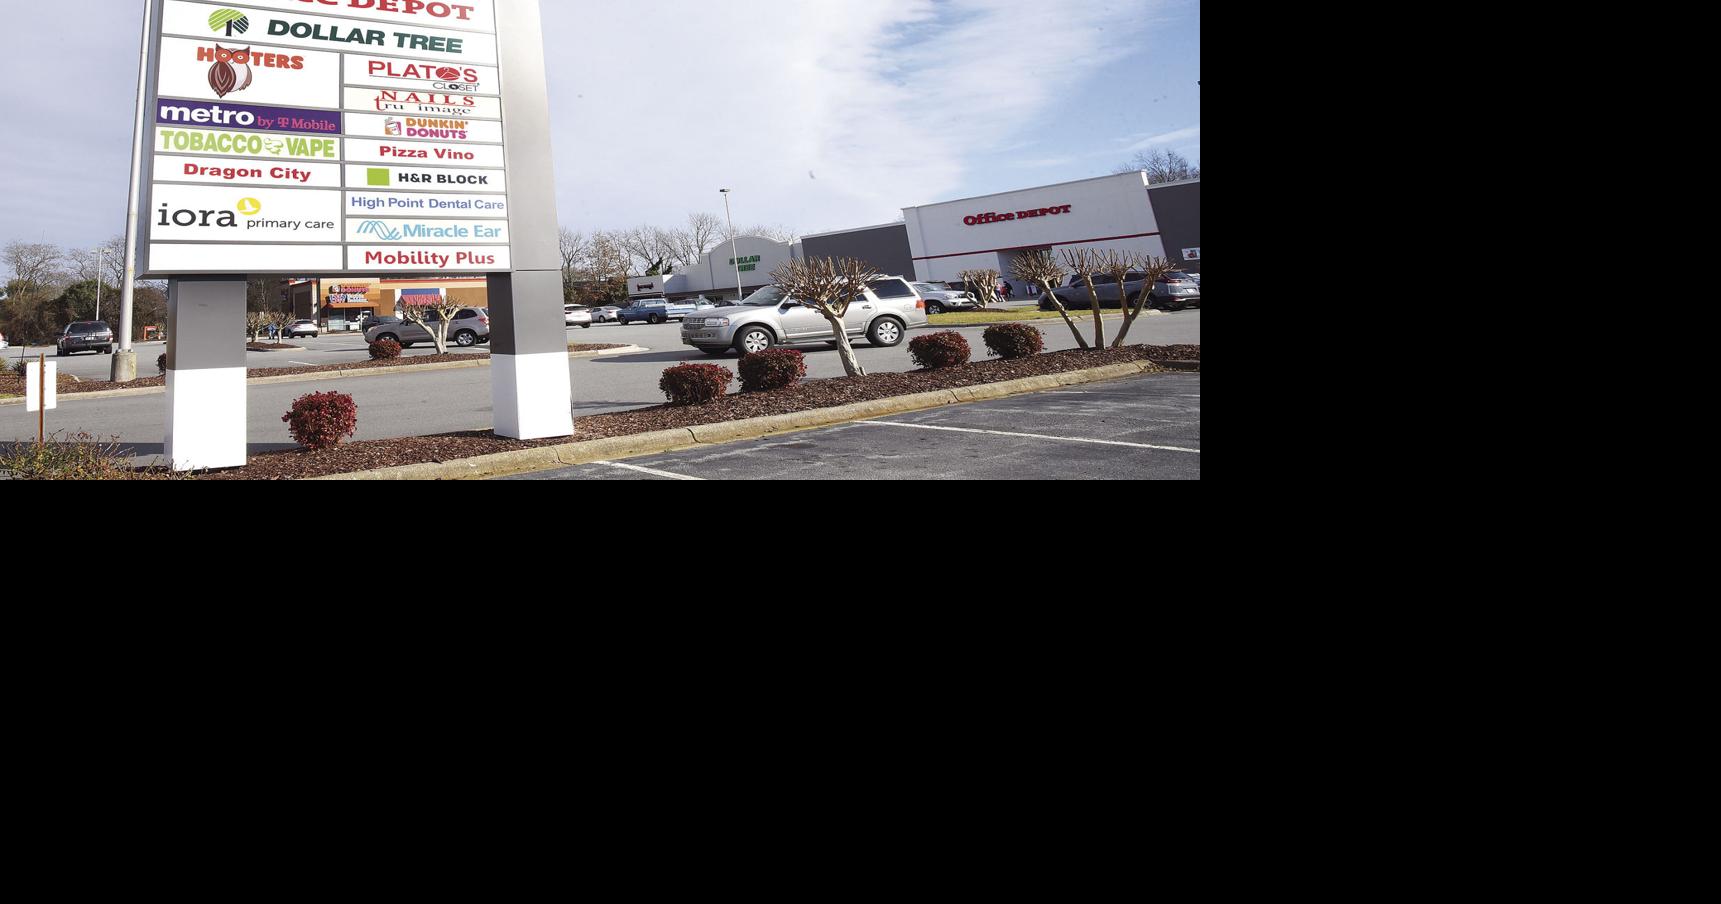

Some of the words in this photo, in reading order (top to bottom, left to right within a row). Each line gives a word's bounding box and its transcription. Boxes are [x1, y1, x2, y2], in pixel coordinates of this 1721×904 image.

[347, 0, 474, 21] DEPOT
[267, 19, 385, 46] DOLLAR
[393, 32, 463, 53] TREE
[197, 45, 304, 70] HOOTERS
[368, 60, 478, 83] PLATO'S
[433, 82, 479, 92] CLOSET
[374, 96, 404, 111] tru
[418, 104, 471, 115] image
[382, 91, 475, 106] NAILS
[160, 105, 255, 126] metro
[257, 116, 274, 128] by
[291, 119, 336, 131] Mobile
[406, 117, 468, 130] DUNKIN'
[406, 128, 467, 140] DONUTS
[160, 130, 262, 154] TOBACCO
[285, 137, 335, 158] VAPE
[379, 145, 428, 158] Pizza
[433, 148, 475, 160] Vino
[183, 163, 262, 180] Dragon
[270, 167, 312, 182] City
[398, 172, 432, 183] H&R
[436, 174, 489, 185] BLOCK
[351, 196, 385, 209] High
[388, 197, 425, 209] Point
[428, 198, 472, 209] Dental
[474, 199, 505, 210] Care
[157, 202, 238, 228] iora
[246, 218, 301, 231] primary
[305, 221, 335, 229] care
[963, 211, 1015, 226] Office
[1015, 204, 1072, 219] DEPOT
[403, 223, 469, 238] Miracle
[473, 225, 501, 238] Ear
[365, 250, 450, 268] Mobility
[456, 251, 495, 265] Plus
